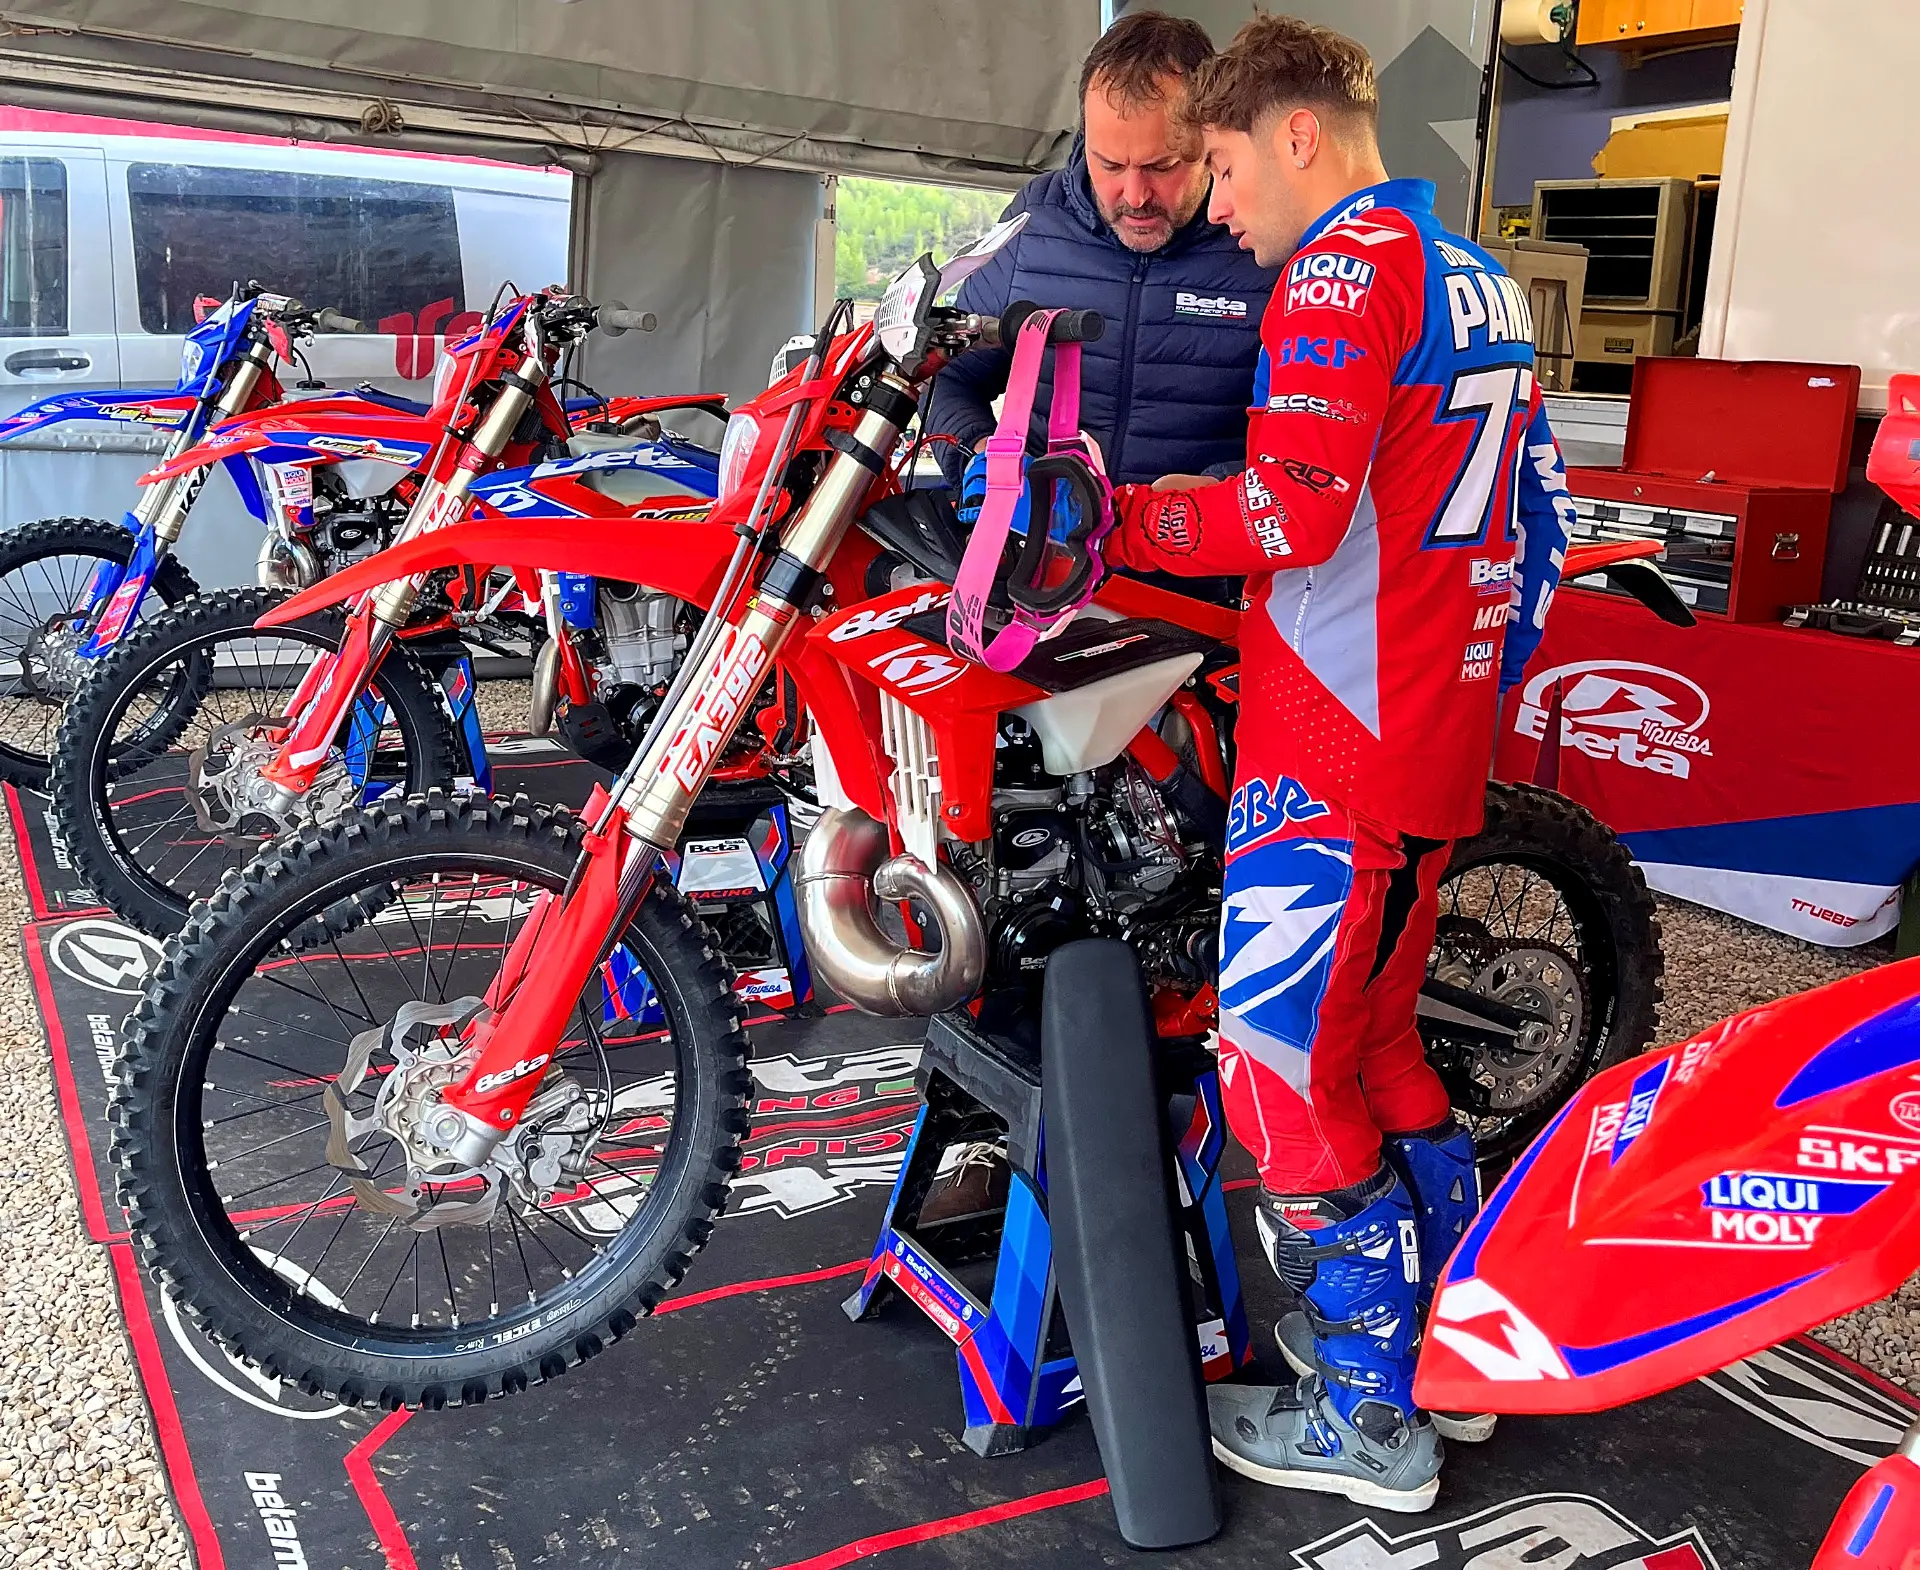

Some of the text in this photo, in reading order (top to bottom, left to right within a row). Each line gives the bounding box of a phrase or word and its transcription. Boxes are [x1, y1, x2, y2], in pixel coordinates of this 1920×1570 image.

[1290, 255, 1371, 285] LIQUI
[1176, 293, 1247, 311] Beta
[1287, 280, 1366, 311] MOLY
[1444, 271, 1534, 350] PAND
[1253, 515, 1293, 559] SAIZ
[1305, 580, 1313, 591] BY
[1464, 642, 1494, 661] LIQUI
[1461, 661, 1492, 680] MOLY
[1514, 702, 1691, 780] Beta
[688, 843, 741, 854] Beta
[688, 886, 755, 900] RACING
[475, 1053, 550, 1093] Beta
[1591, 1101, 1627, 1156] MOLY
[1618, 1088, 1657, 1142] LIQUI
[1797, 1137, 1920, 1174] SKF
[1710, 1176, 1820, 1211] LIQUI
[1711, 1210, 1824, 1242] MOLY
[492, 1316, 541, 1346] EXCEL
[243, 1470, 309, 1570] betam
